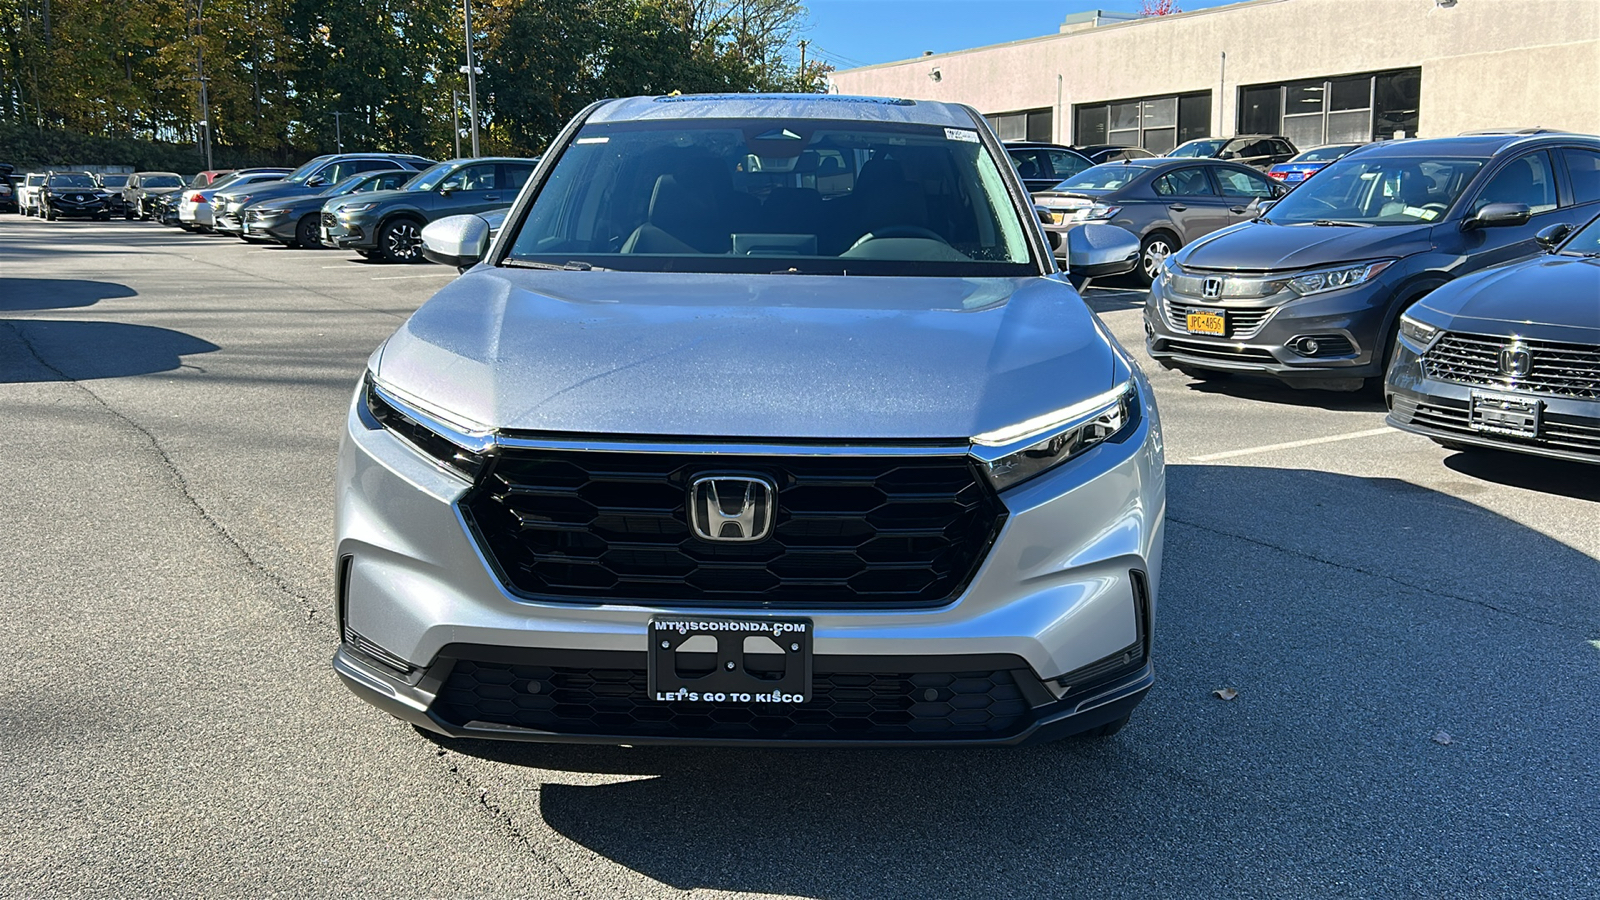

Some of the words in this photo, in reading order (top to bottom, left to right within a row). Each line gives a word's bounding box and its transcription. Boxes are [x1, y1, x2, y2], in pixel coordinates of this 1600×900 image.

[654, 621, 806, 633] MTKISCOHONDA.COM
[656, 692, 699, 702] LET'S
[703, 692, 726, 702] GO
[730, 693, 751, 702] TO
[755, 693, 804, 703] KISCO
